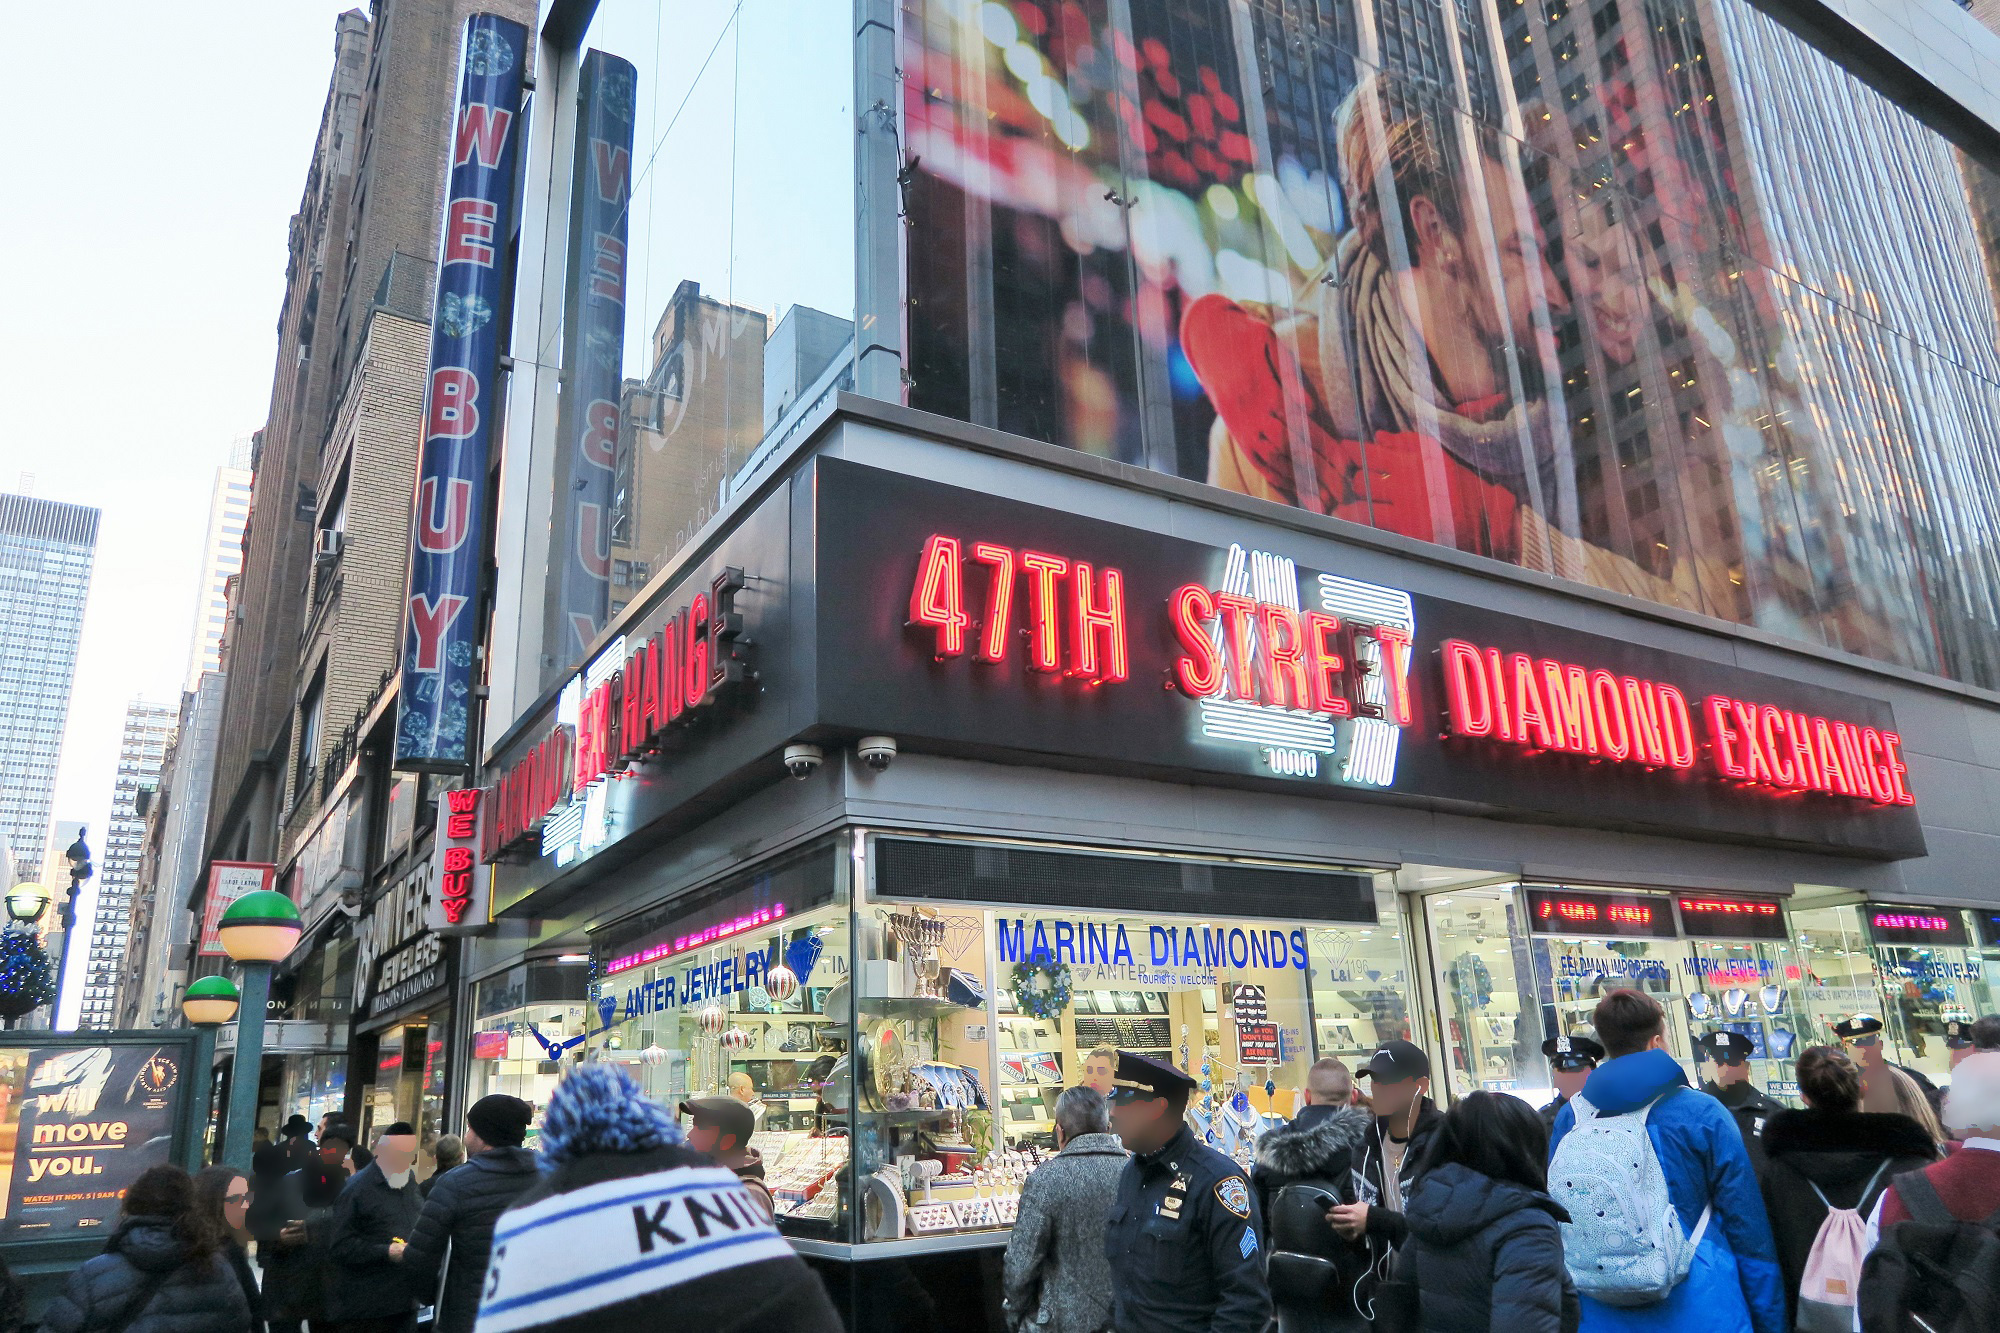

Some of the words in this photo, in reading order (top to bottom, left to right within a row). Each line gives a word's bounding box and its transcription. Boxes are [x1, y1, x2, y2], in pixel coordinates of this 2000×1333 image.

[444, 102, 512, 269] WE
[410, 366, 480, 673] BUY
[574, 565, 744, 793] EXCHANGE
[908, 532, 1130, 685] 47TH
[1167, 582, 1414, 727] STREET
[1440, 638, 1696, 770] DIAMOND
[1701, 694, 1917, 807] EXCHANGE
[446, 788, 481, 839] WE
[372, 850, 436, 960] UNIVERS
[441, 847, 475, 923] BUY
[378, 932, 441, 993] JEWELERS
[998, 917, 1133, 966] MARINA
[1149, 923, 1308, 970] DIAMONDS
[1725, 958, 1774, 977] JEWELRY
[624, 974, 676, 1021] ANTER
[681, 946, 775, 1006] JEWELRY
[1138, 974, 1177, 985] TOURISTS
[1180, 975, 1218, 986] WELCOME
[1930, 961, 1981, 979] JEWELRY
[41, 1058, 69, 1082] It
[1782, 1082, 1798, 1090] BUY
[37, 1087, 98, 1113] will
[33, 1120, 129, 1144] move
[27, 1155, 103, 1182] you.
[23, 1194, 53, 1203] WATCH
[64, 1193, 84, 1201] NOV.
[97, 1191, 115, 1199] 9AM
